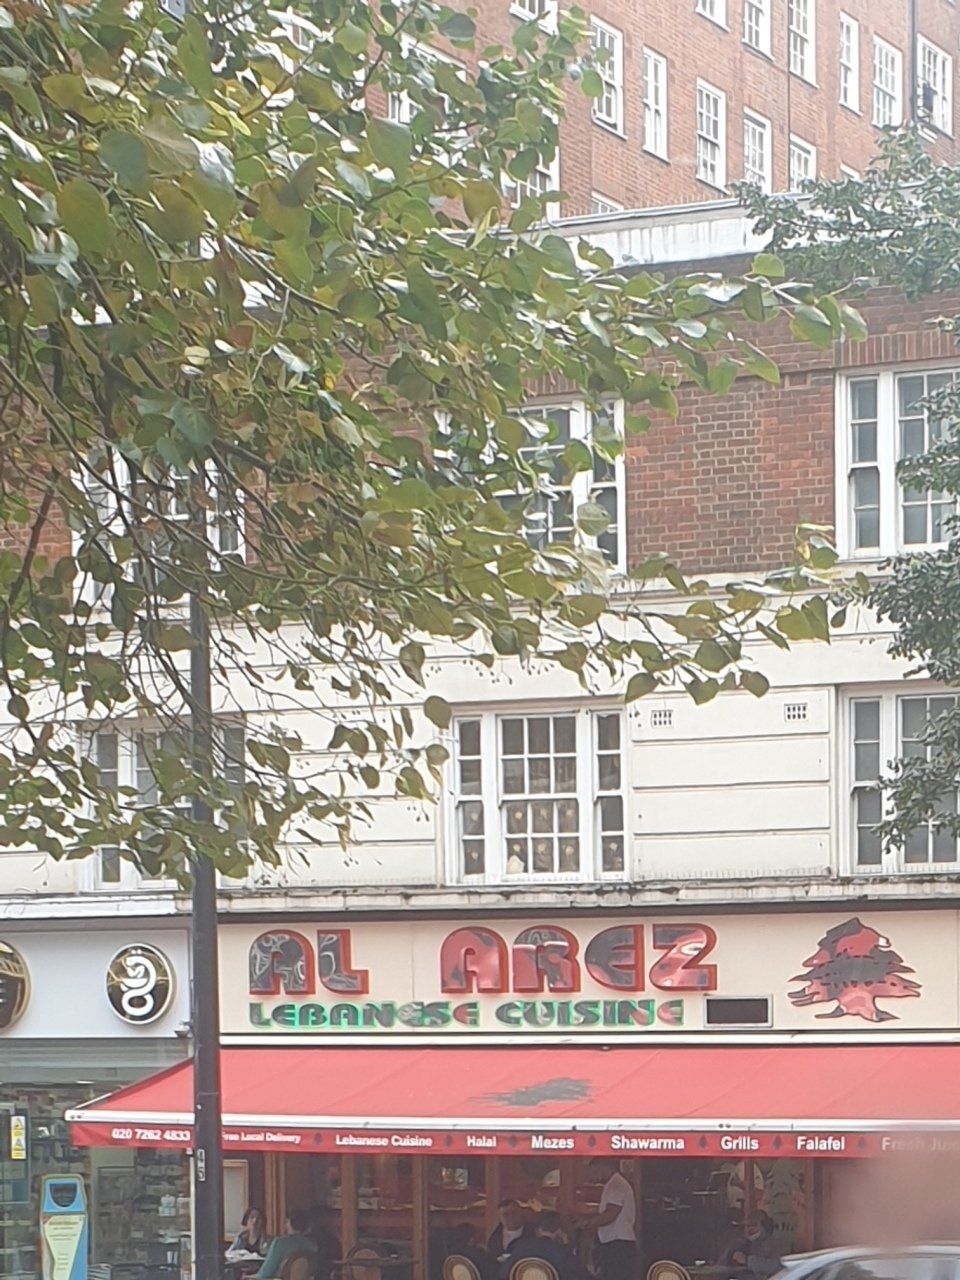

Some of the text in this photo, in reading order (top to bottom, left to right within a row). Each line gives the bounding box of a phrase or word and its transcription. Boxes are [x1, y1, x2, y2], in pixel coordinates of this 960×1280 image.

[249, 925, 718, 994] AL AREZ
[249, 999, 684, 1028] LEBANESE CUISINE
[111, 1128, 132, 1140] 020
[241, 1131, 264, 1142] Local
[266, 1131, 301, 1145] Delivery
[335, 1134, 432, 1147] Lebanese Cuisine
[467, 1135, 496, 1148] Halal
[531, 1136, 575, 1150] Mezes
[611, 1135, 685, 1150] Shawarma
[721, 1136, 759, 1151] Grills
[797, 1135, 845, 1151] Falafel
